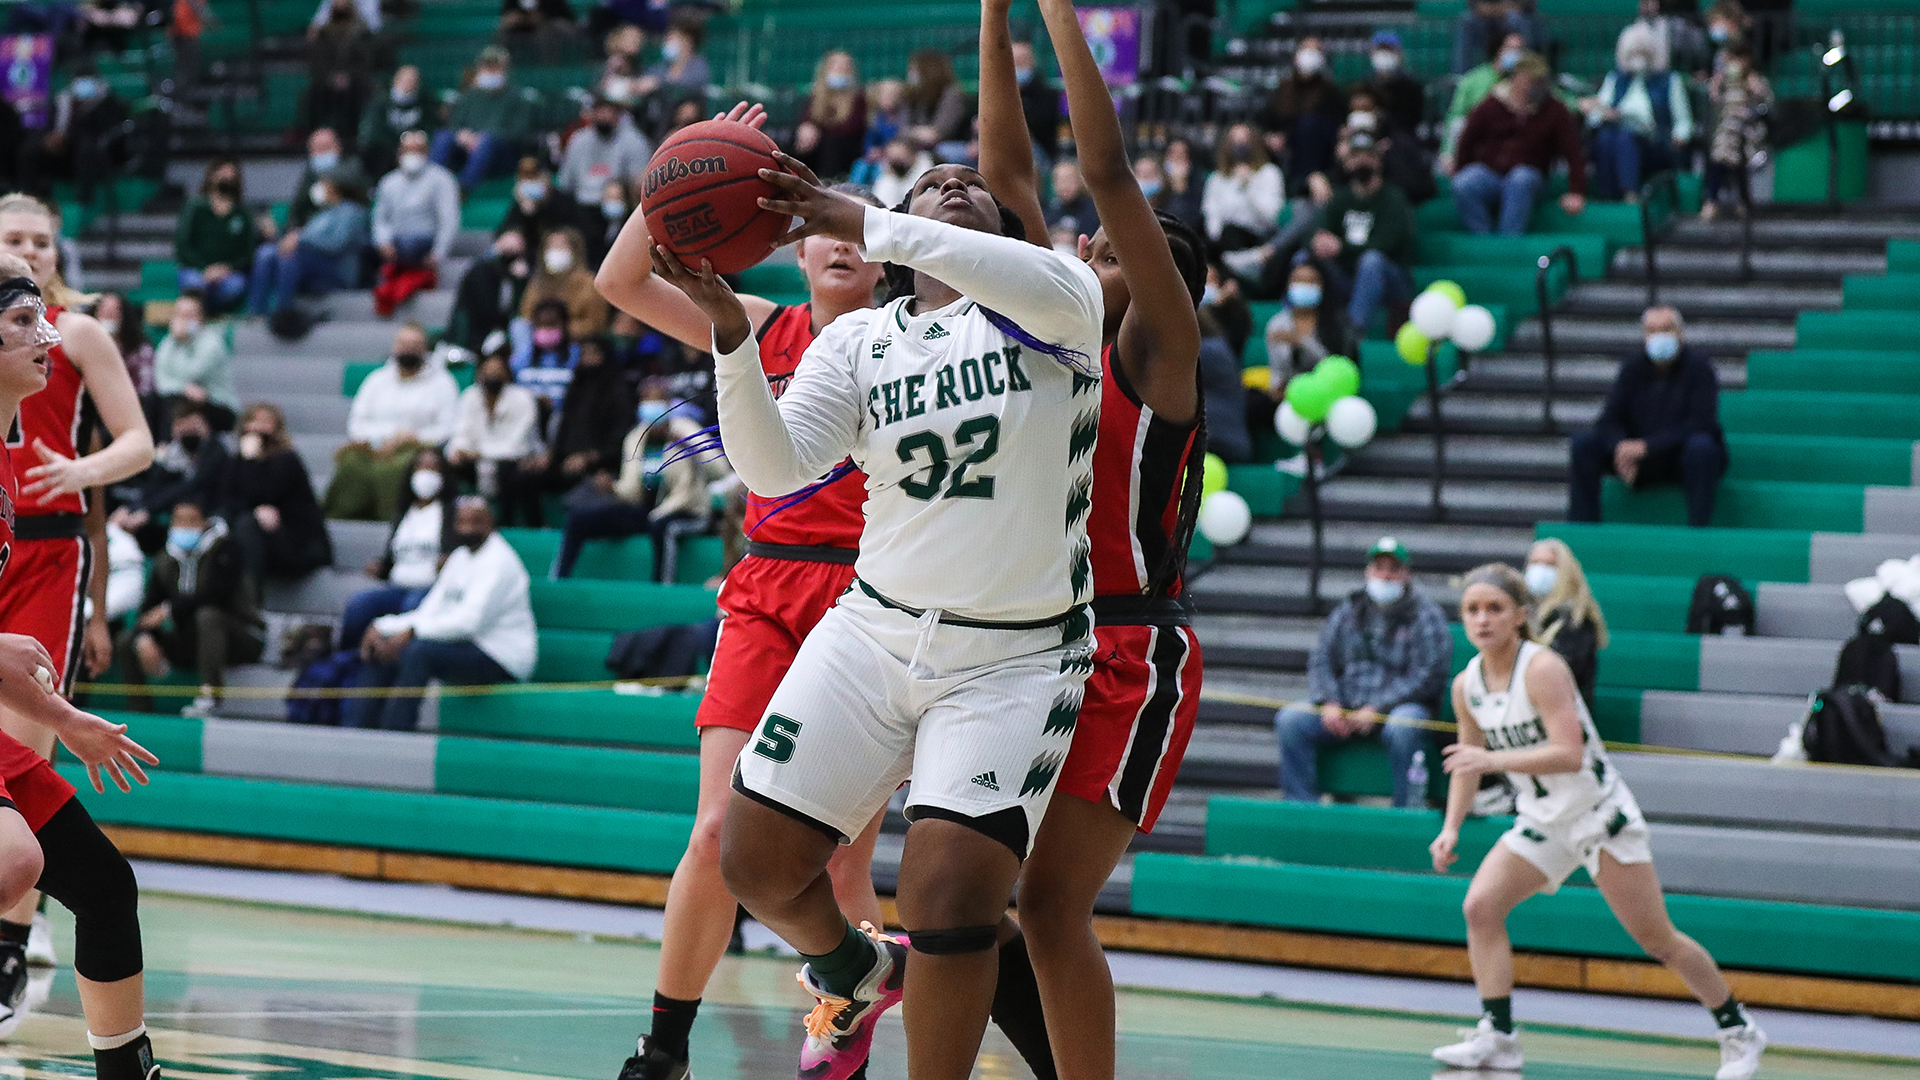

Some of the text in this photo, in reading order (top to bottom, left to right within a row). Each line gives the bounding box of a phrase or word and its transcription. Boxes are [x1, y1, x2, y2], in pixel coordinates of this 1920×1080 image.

[644, 156, 727, 198] Wilson
[665, 207, 721, 239] PSAC
[922, 331, 951, 340] adidas
[867, 345, 1032, 431] THE ROCK
[895, 413, 1000, 502] 32
[752, 711, 803, 764] S
[970, 776, 1000, 791] adidas
